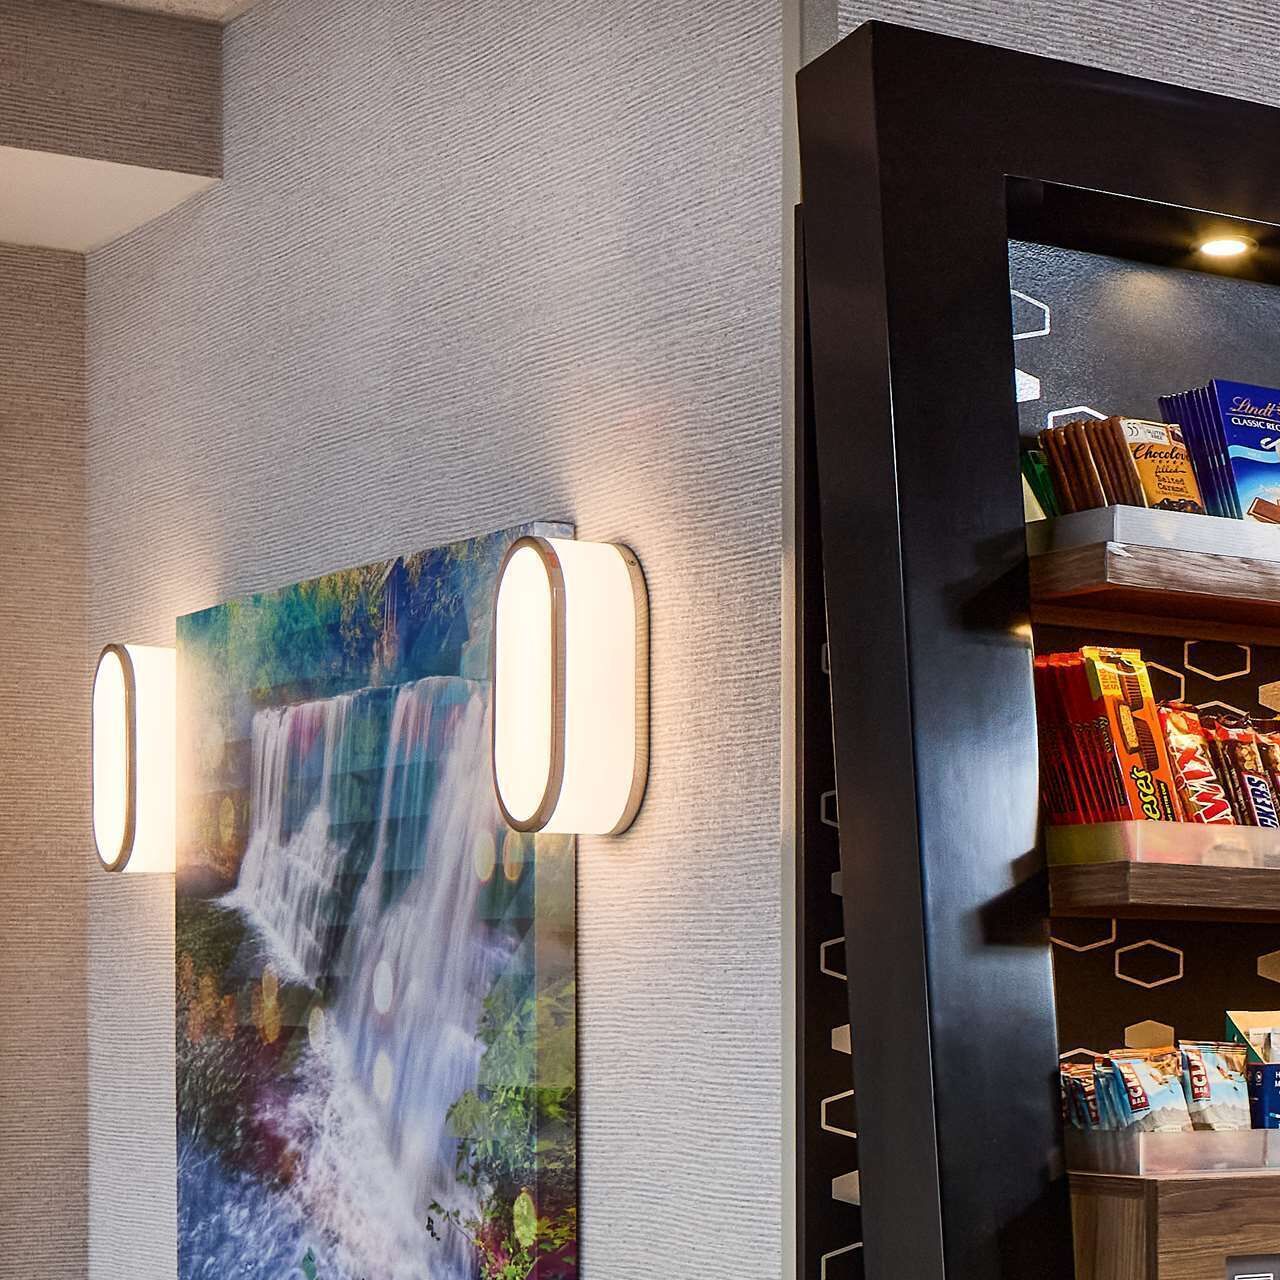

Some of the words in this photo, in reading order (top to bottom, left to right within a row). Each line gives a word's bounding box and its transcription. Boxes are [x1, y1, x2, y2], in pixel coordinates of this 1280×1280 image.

[1229, 396, 1274, 418] Lindt
[1231, 417, 1266, 429] CLASSIC
[1133, 443, 1190, 461] Chocolov
[1246, 775, 1279, 828] CKERS
